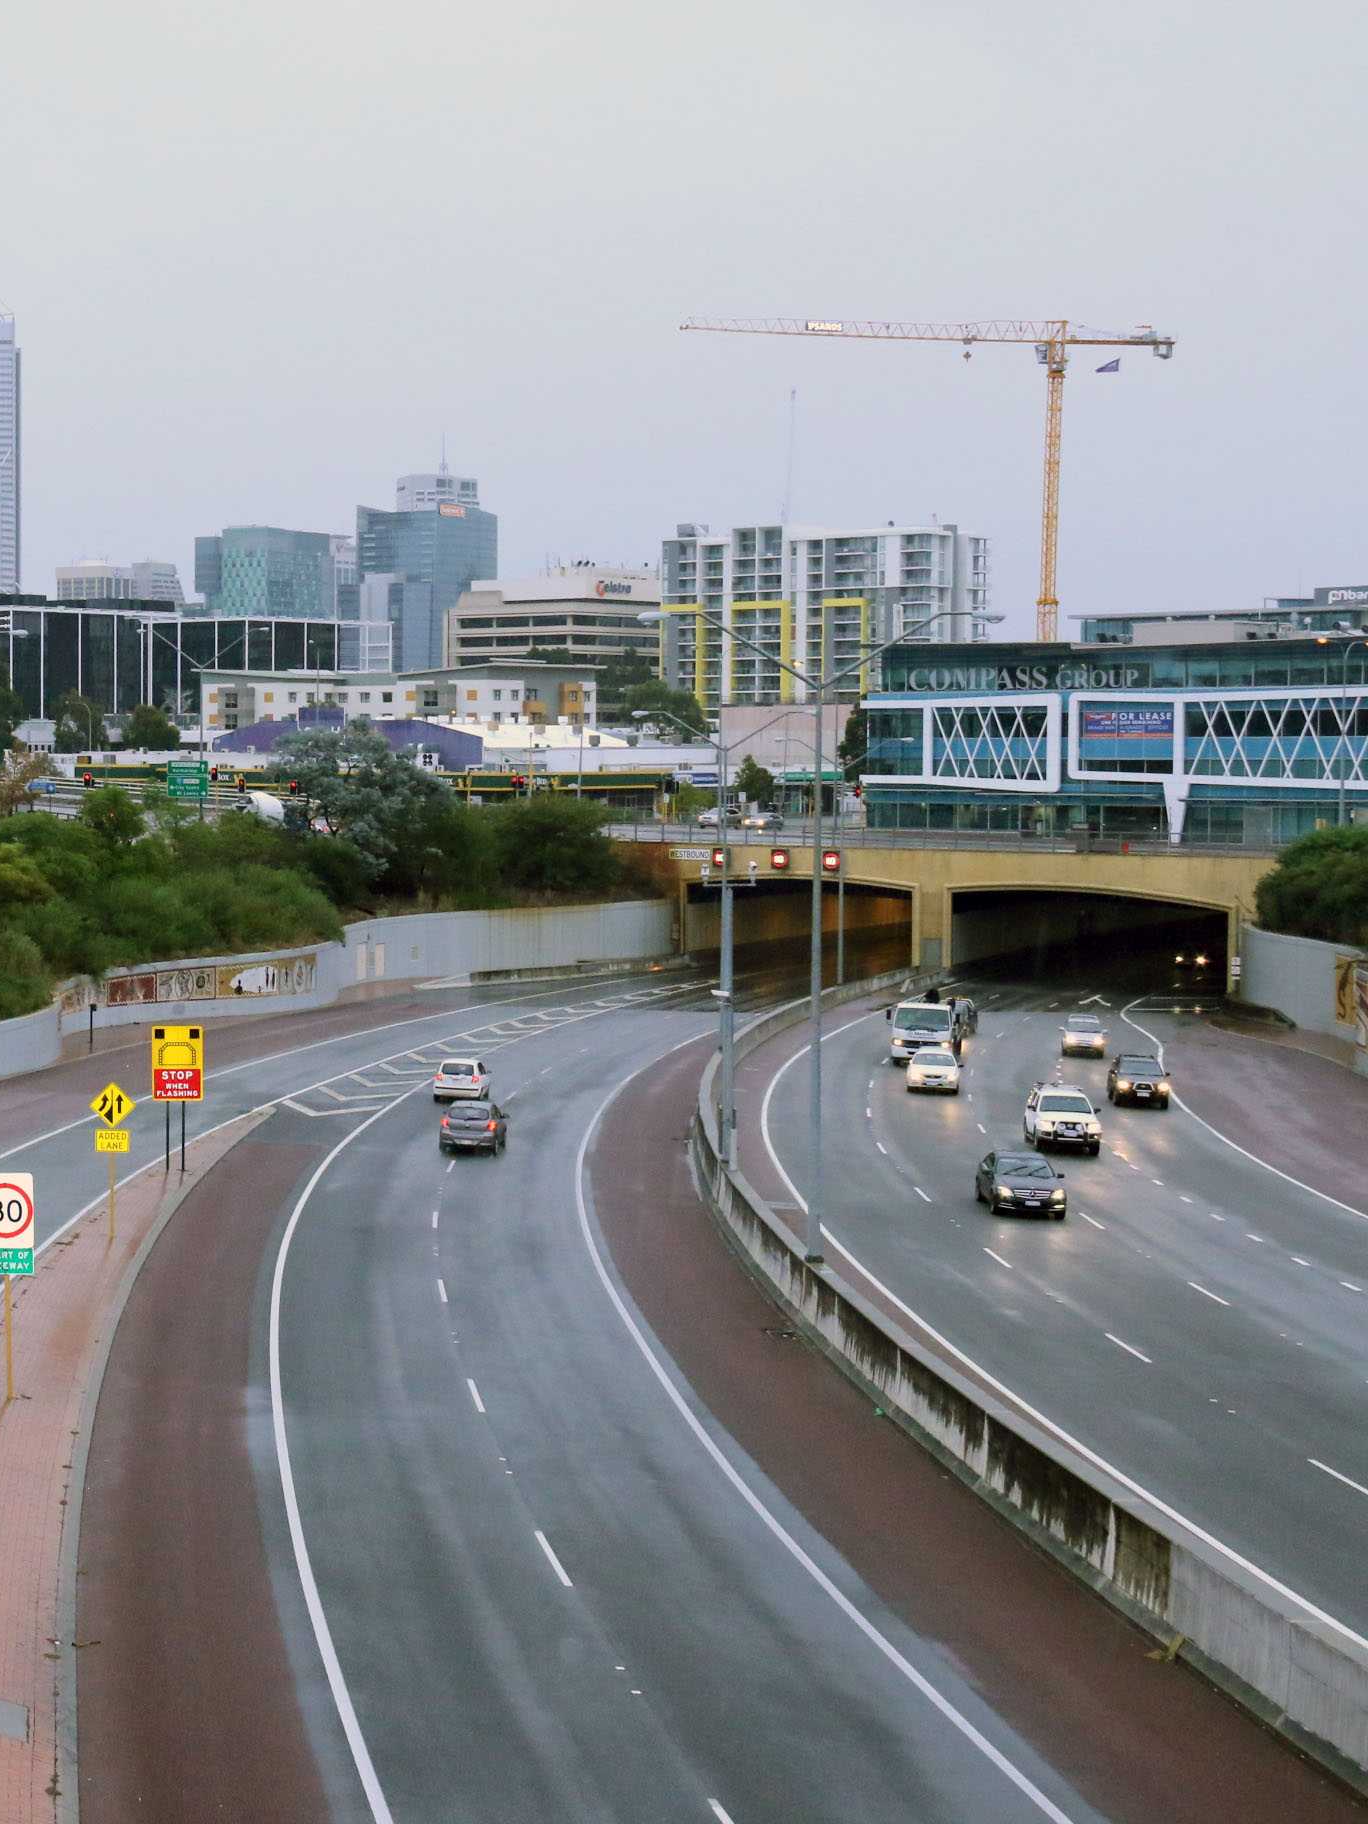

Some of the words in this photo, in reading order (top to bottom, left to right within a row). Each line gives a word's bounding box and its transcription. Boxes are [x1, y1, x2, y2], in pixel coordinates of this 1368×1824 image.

[595, 580, 632, 598] Telstra
[907, 666, 1049, 692] COMPASS
[1054, 667, 1140, 690] GROUP
[1111, 712, 1136, 721] FOR
[1139, 712, 1173, 721] LEASE
[670, 850, 711, 859] WESTBOUND
[161, 1070, 194, 1080] STOP
[98, 1132, 127, 1141] ADDED
[100, 1142, 125, 1150] LANE
[17, 1250, 31, 1259] OF
